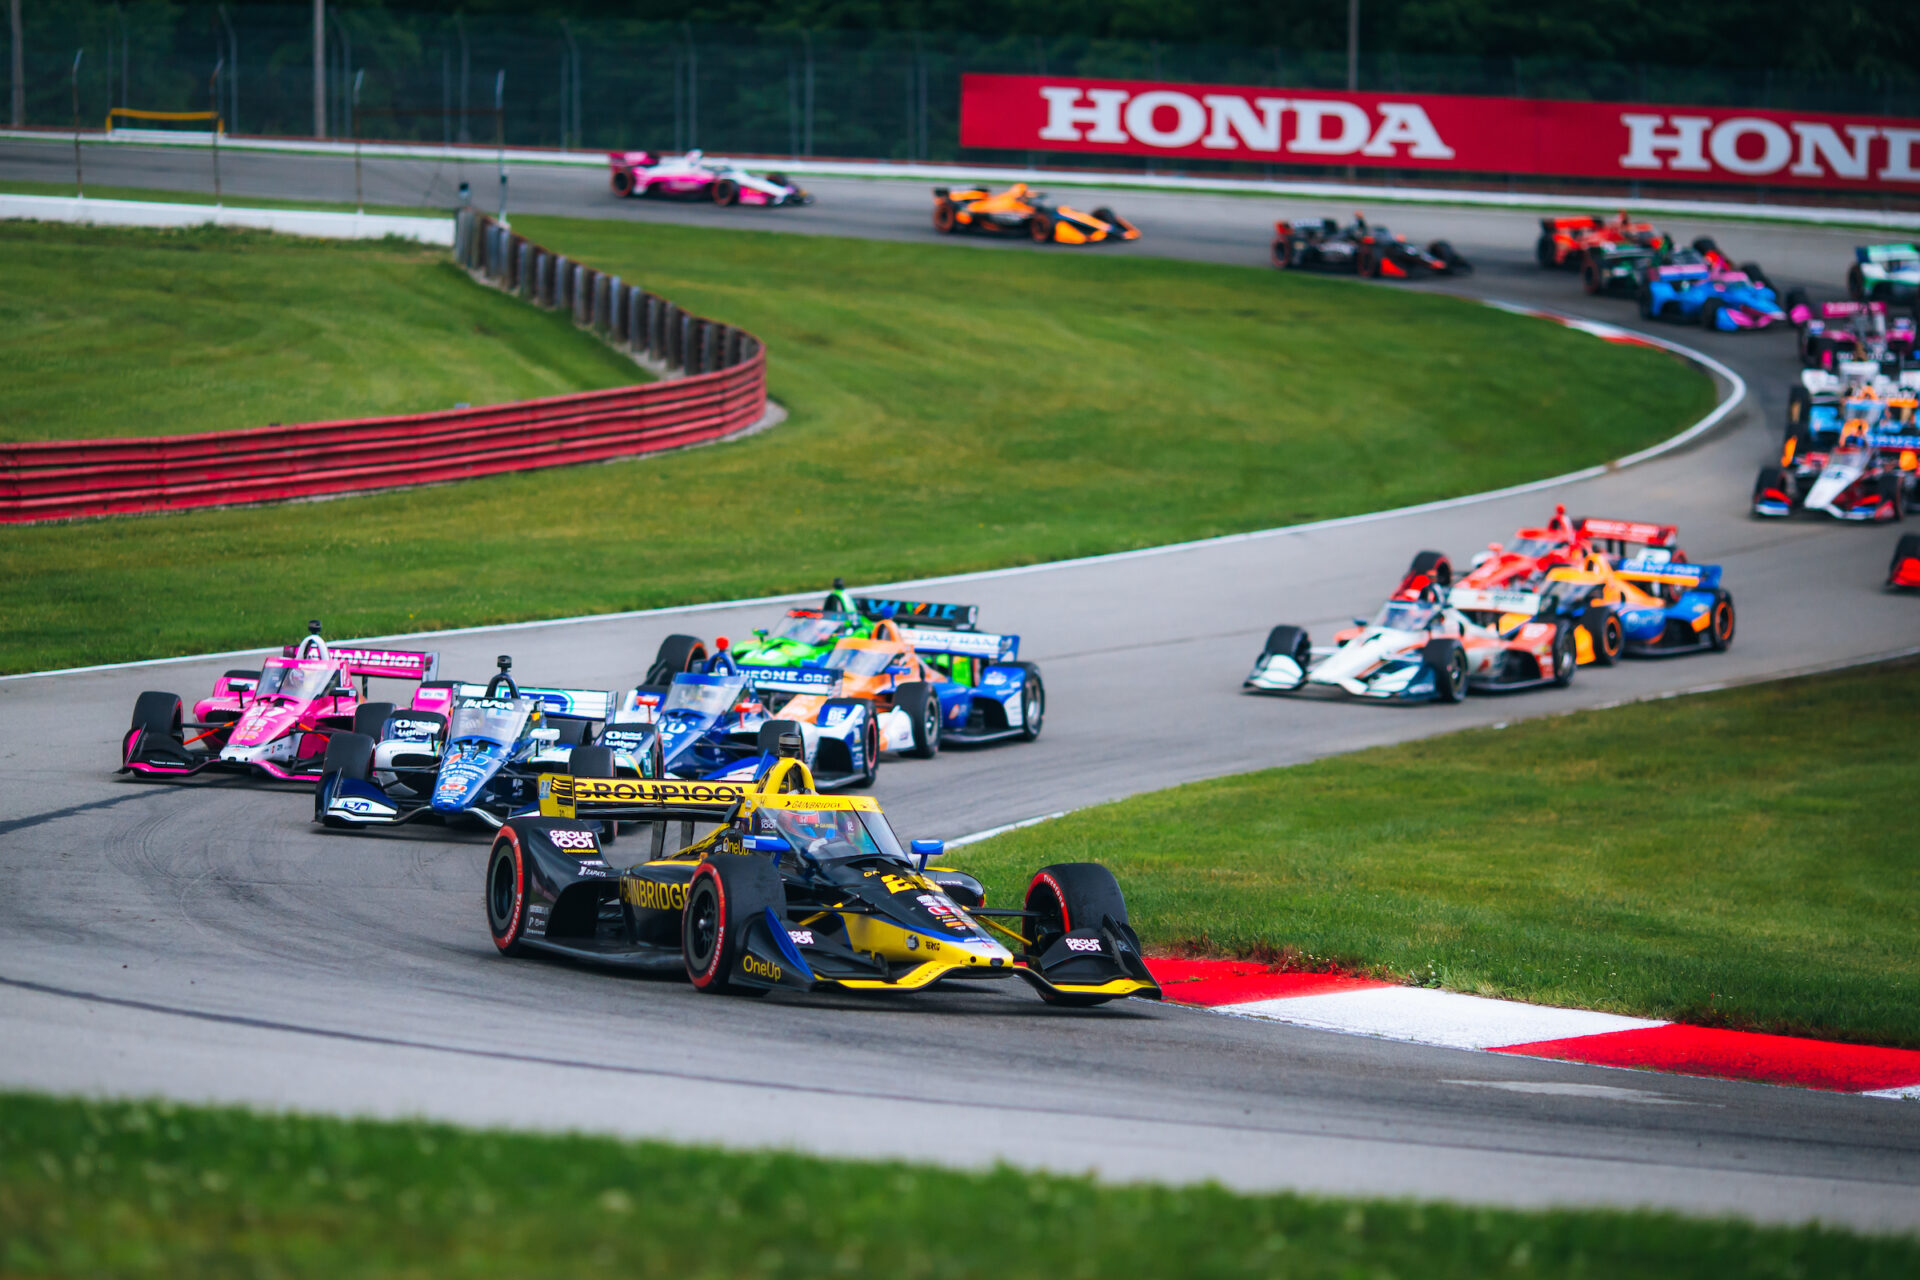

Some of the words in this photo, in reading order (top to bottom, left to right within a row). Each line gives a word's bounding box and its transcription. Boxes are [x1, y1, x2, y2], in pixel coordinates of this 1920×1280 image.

[1038, 85, 1456, 160] HONDA
[550, 830, 593, 840] GROUP
[551, 838, 594, 848] 1001
[585, 868, 607, 878] ZAPATA
[1044, 874, 1064, 908] Firestone
[788, 930, 812, 938] OUP
[1065, 938, 1100, 946] GROUP
[1067, 943, 1102, 952] 1001
[743, 955, 782, 982] OneUp
